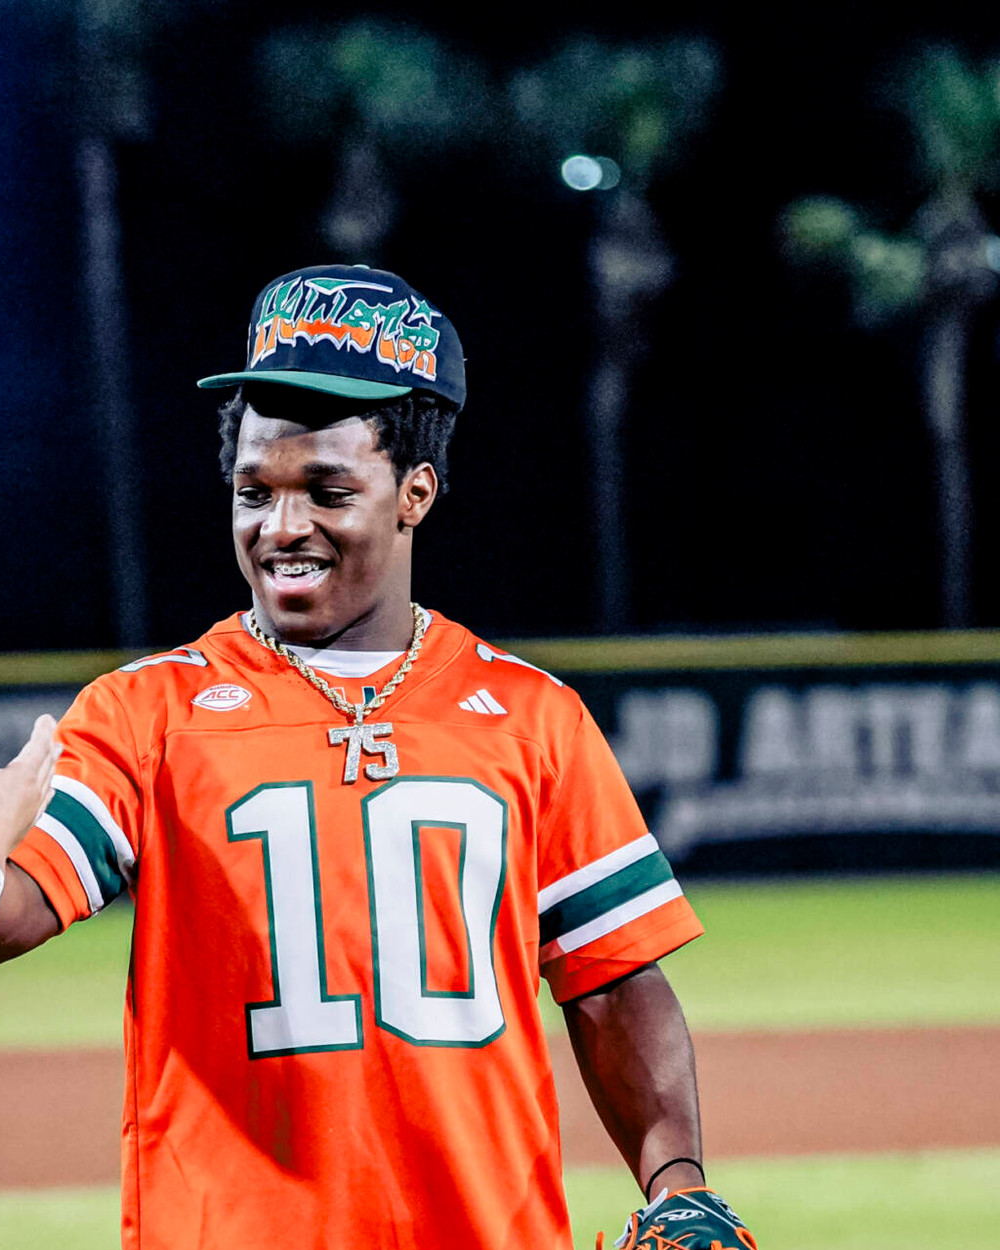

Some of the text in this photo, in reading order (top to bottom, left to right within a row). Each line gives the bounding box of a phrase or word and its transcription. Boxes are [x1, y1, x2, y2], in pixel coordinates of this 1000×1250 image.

[202, 690, 240, 699] ACC
[328, 722, 400, 783] 75
[226, 776, 507, 1060] 10
